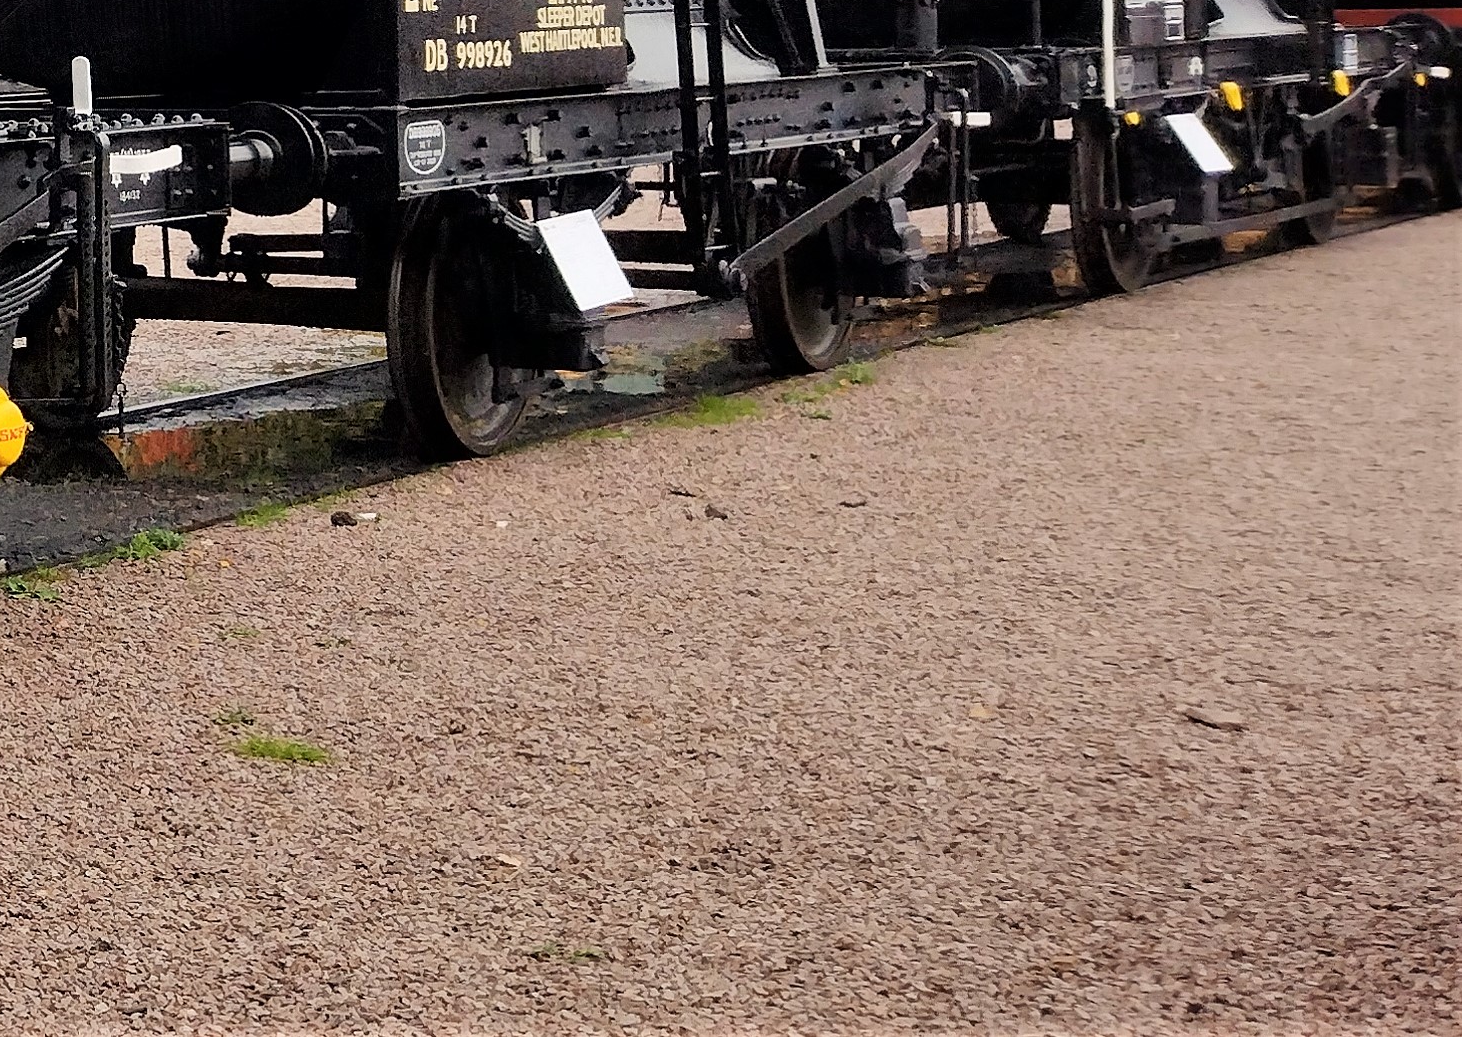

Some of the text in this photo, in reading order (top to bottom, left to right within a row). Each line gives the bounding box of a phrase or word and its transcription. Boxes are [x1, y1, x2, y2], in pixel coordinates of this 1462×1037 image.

[537, 4, 606, 28] SLEEPER DEPOT
[519, 30, 545, 53] WEST
[424, 39, 512, 72] DB 998926
